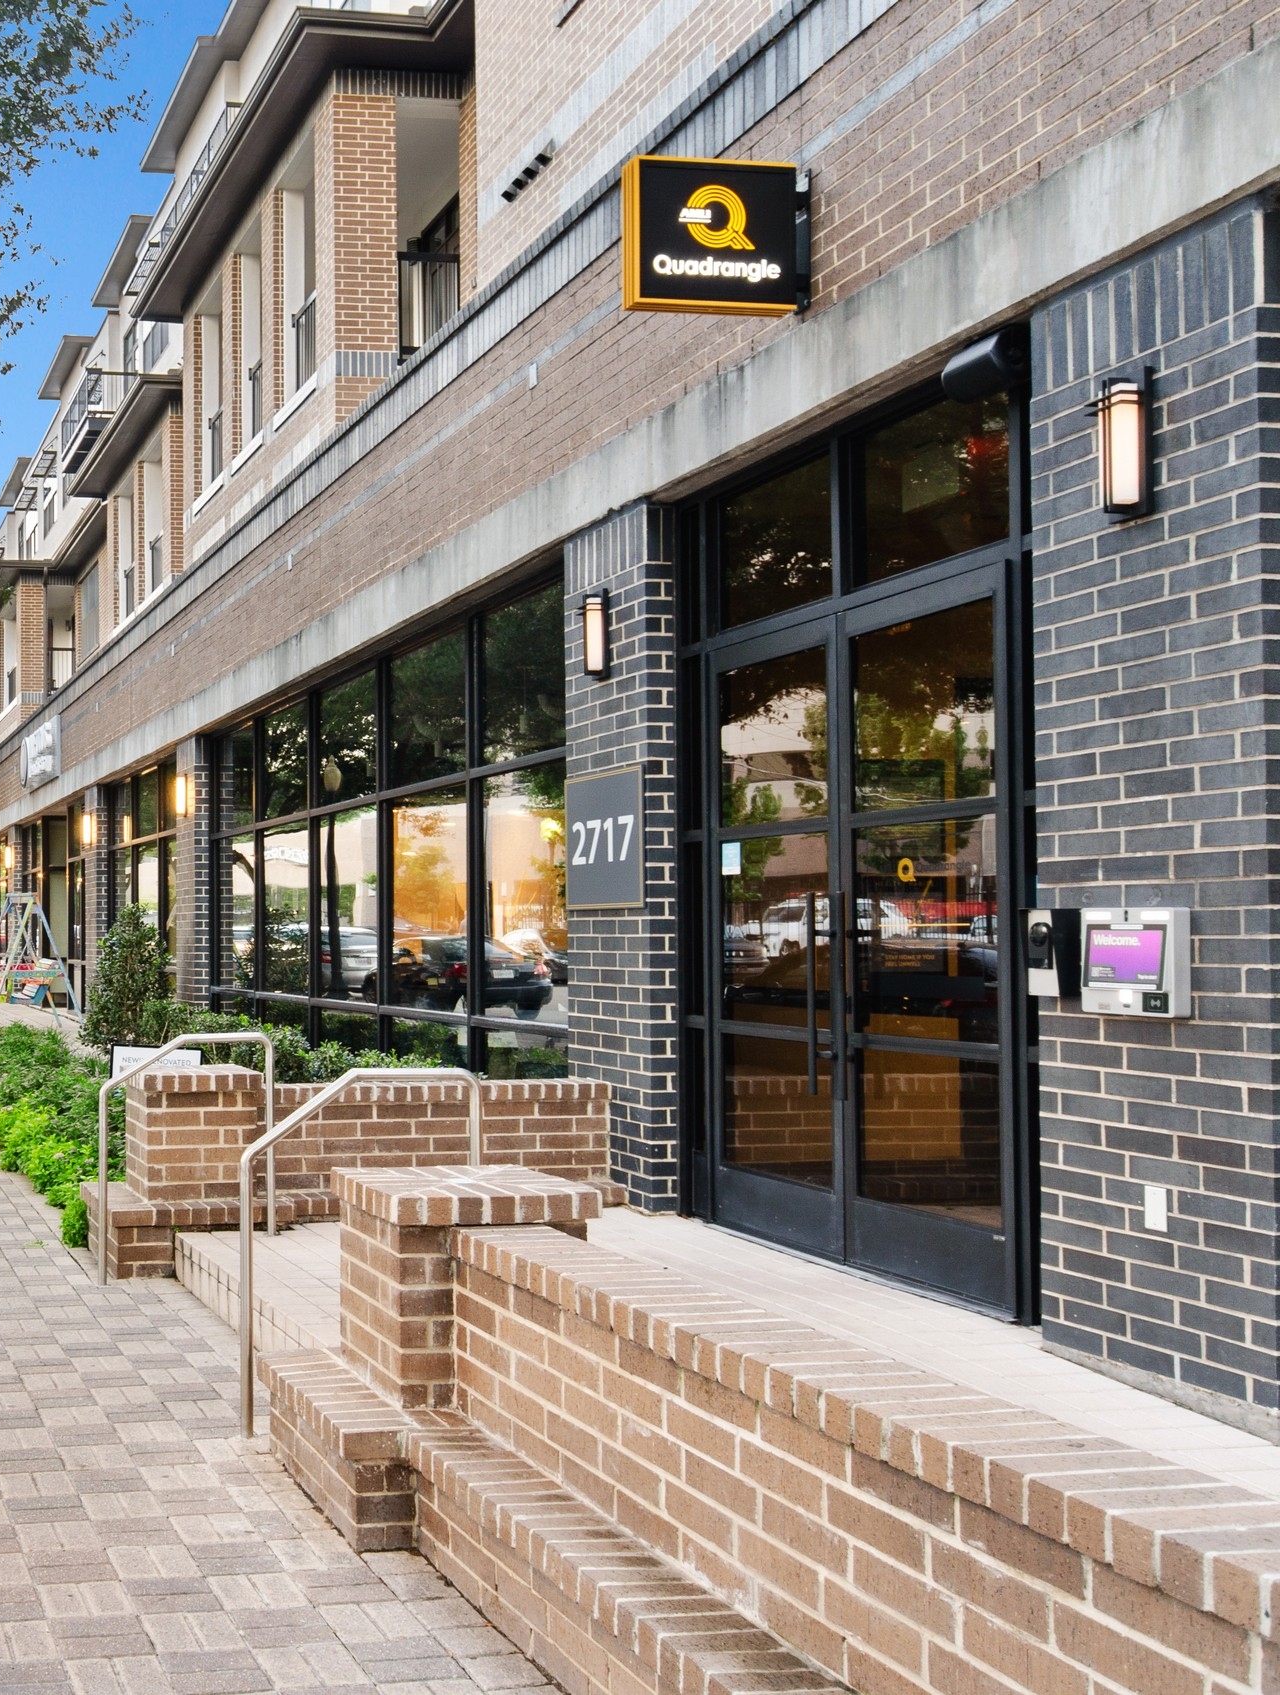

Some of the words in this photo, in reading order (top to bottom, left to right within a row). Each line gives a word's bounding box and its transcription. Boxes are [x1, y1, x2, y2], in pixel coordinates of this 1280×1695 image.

[652, 253, 782, 282] Quadrangle
[571, 814, 635, 866] 2717
[1093, 934, 1141, 946] Welcome.
[122, 1056, 145, 1064] NEW
